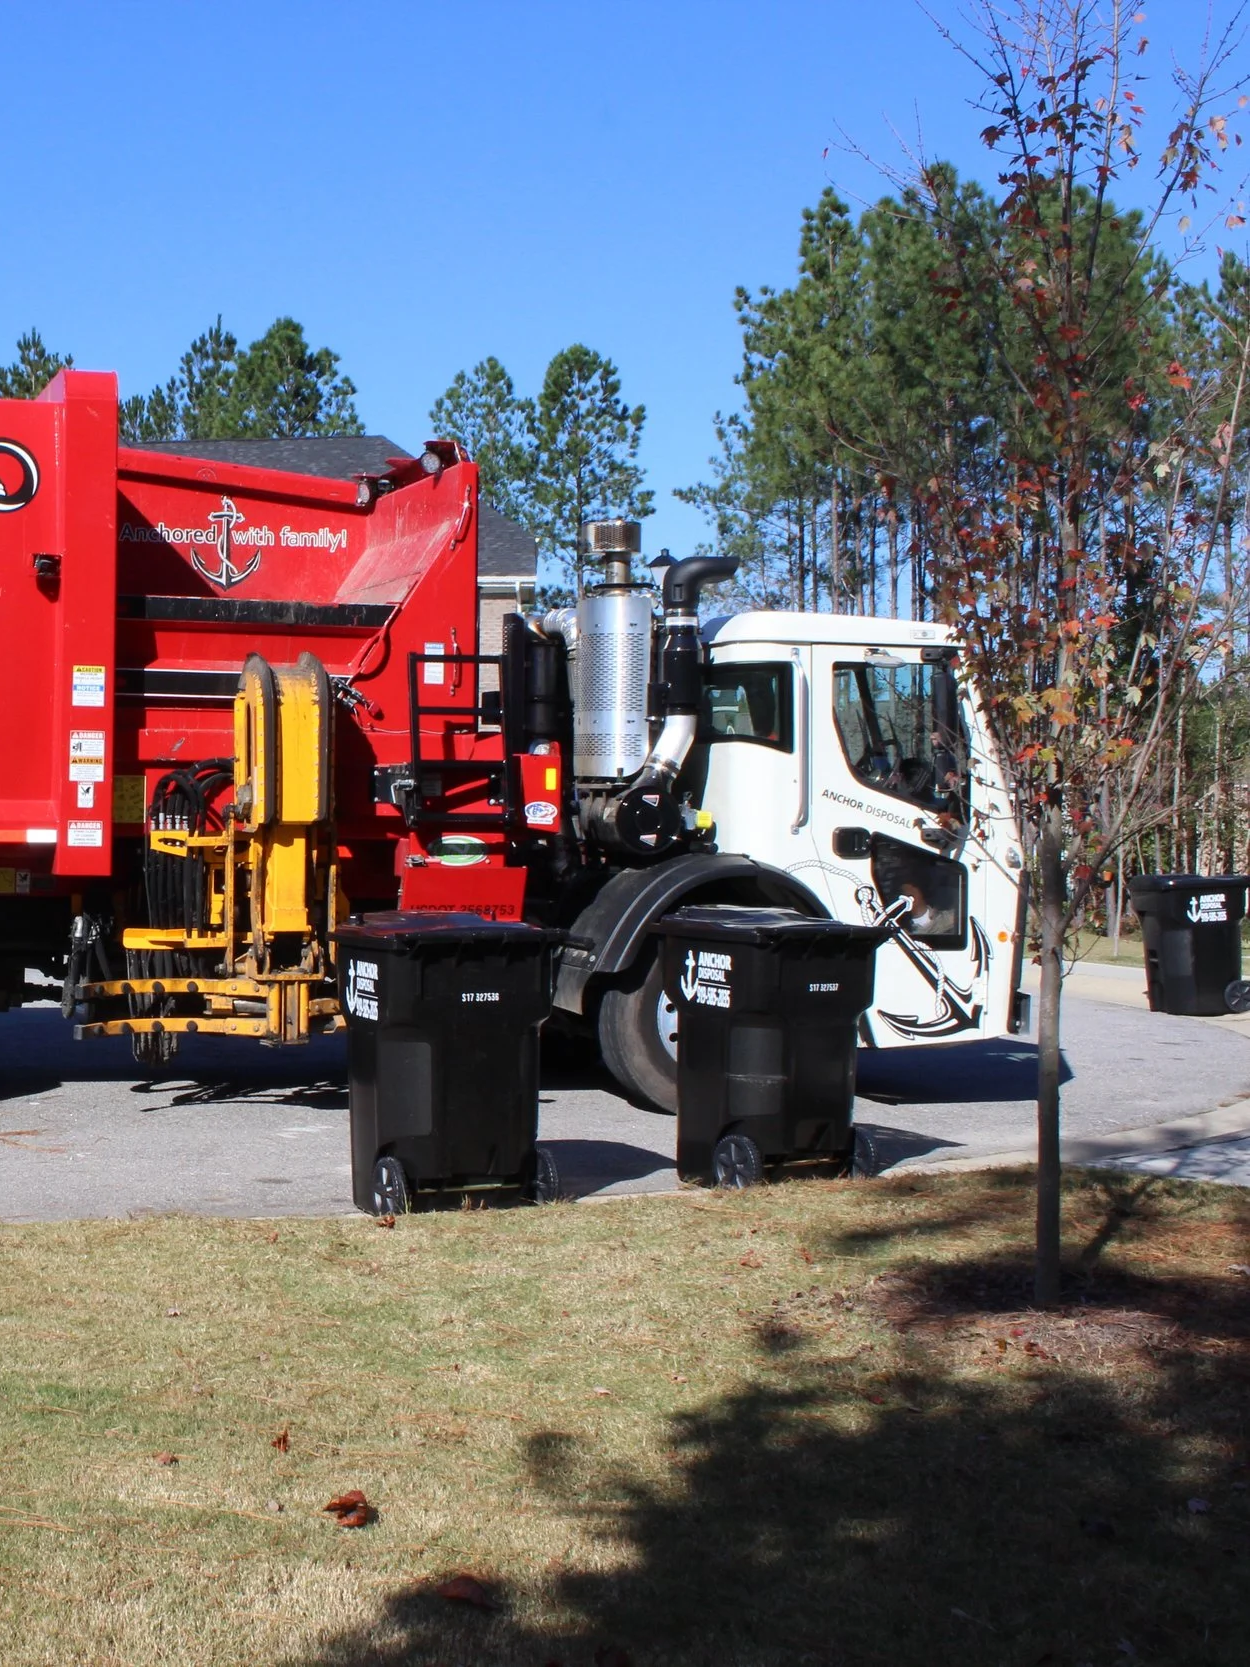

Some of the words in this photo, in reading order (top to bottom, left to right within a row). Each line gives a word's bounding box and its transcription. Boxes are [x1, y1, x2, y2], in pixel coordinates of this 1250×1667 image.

[119, 522, 218, 545] Anchored
[231, 525, 275, 546] with
[279, 526, 348, 553] family!
[822, 789, 864, 811] ANCHOR
[865, 804, 911, 829] DISPOSAL
[356, 960, 379, 980] ANCHOR
[698, 951, 732, 971] ANCHOR
[698, 966, 726, 982] DISPOSAL
[461, 993, 475, 1002] S17
[809, 983, 820, 992] S17
